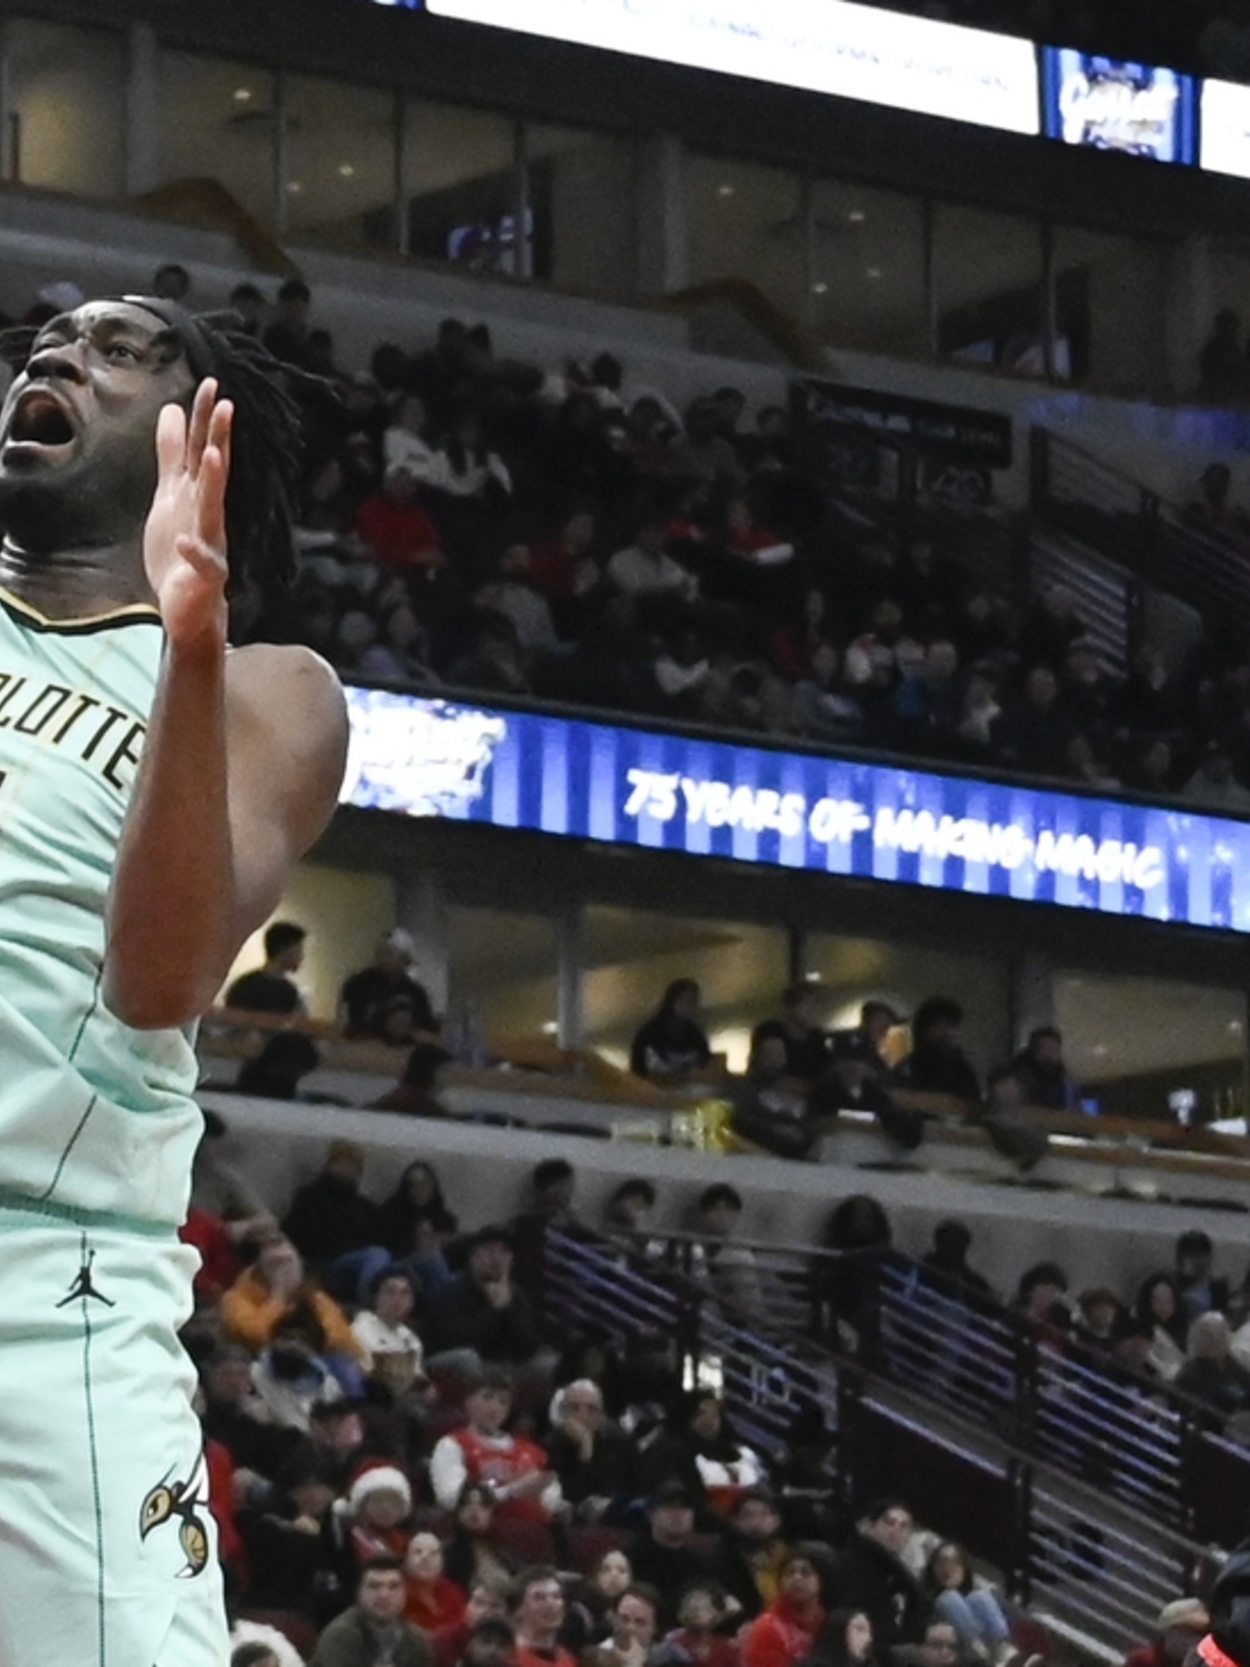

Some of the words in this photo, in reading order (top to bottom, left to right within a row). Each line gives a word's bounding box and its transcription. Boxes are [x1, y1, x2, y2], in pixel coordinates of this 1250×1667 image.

[624, 768, 680, 822] 75
[680, 777, 807, 837] YEARS
[809, 797, 870, 844] OF
[873, 806, 1035, 869] MAKING
[1035, 829, 1166, 889] MAGIC
